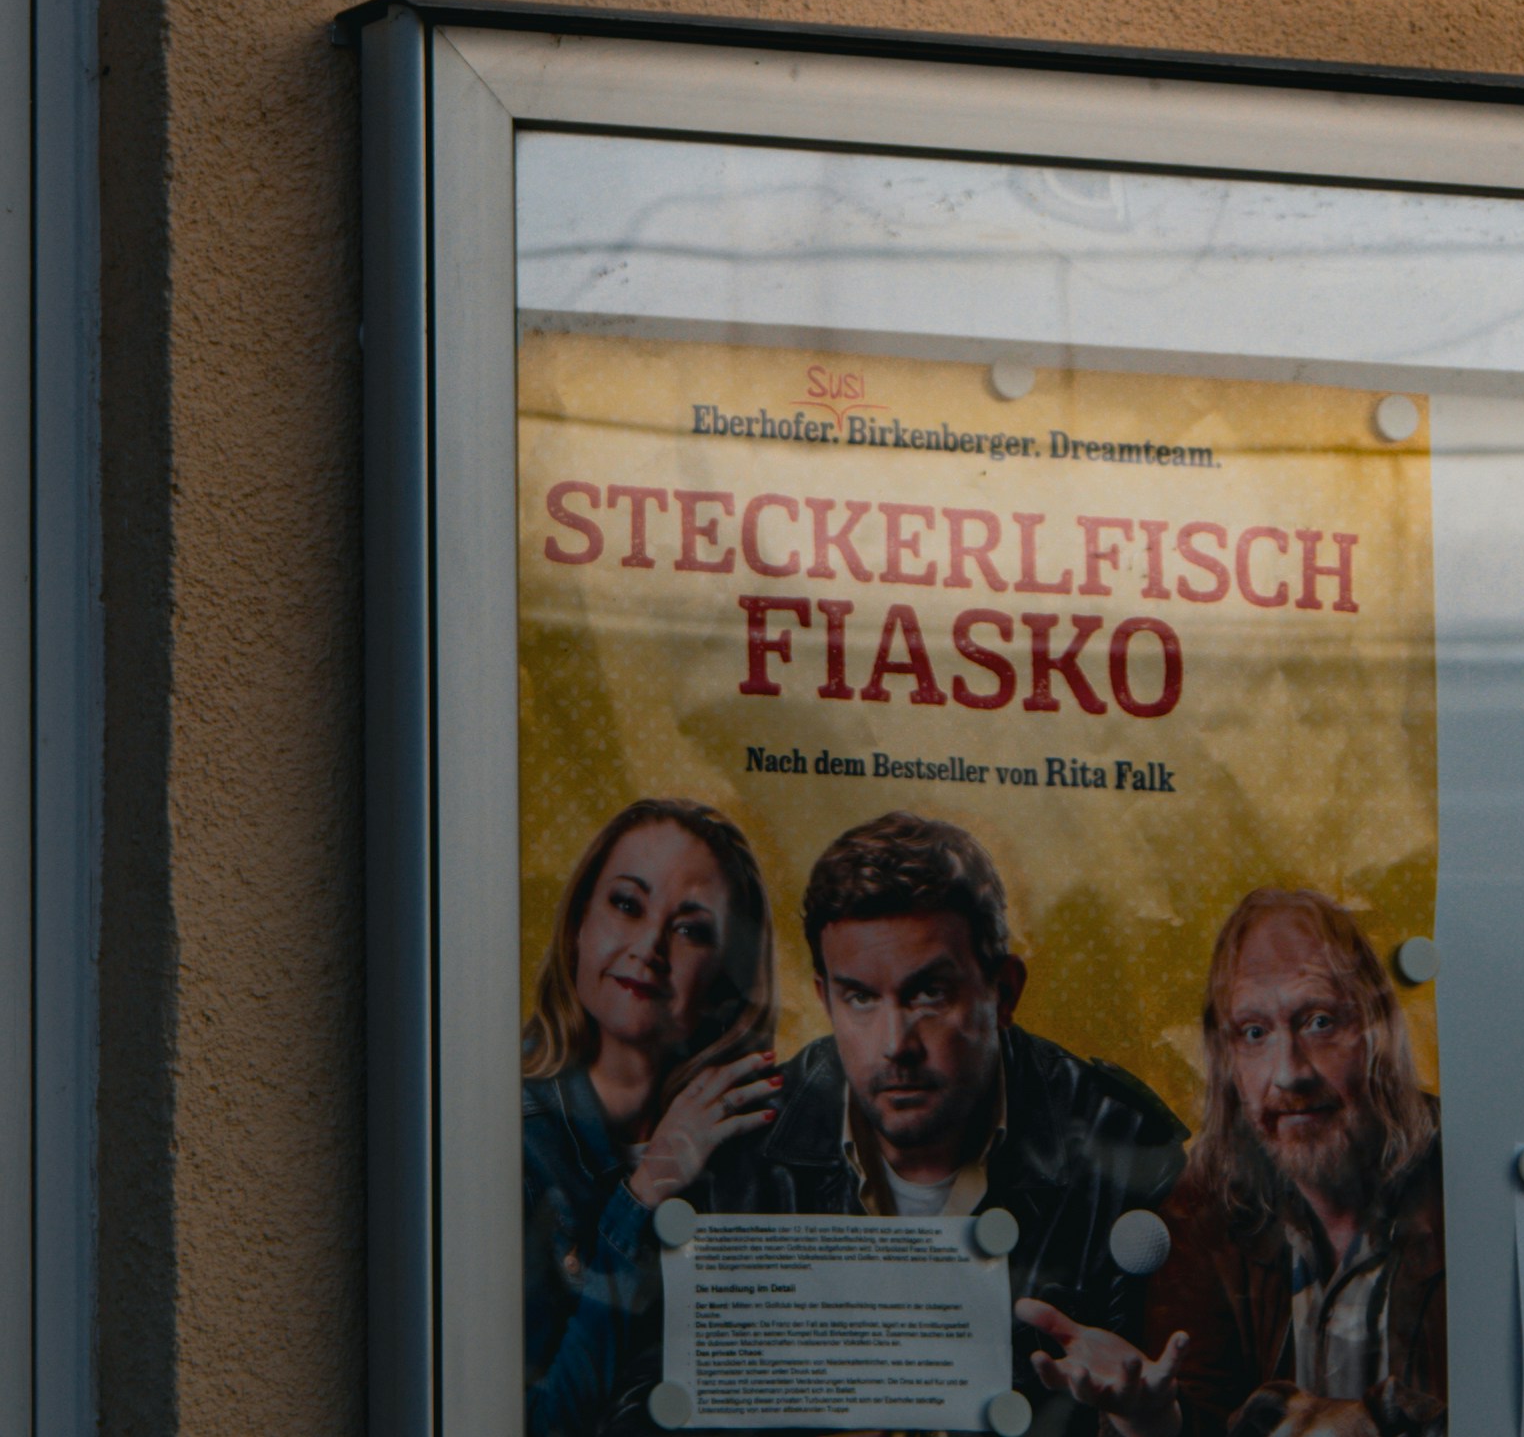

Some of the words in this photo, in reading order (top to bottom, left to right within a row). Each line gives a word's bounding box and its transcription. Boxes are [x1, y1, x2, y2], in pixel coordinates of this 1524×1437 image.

[806, 366, 866, 401] Susi
[691, 405, 840, 445] Eberhofer.
[847, 416, 1038, 461] Birkenberger.
[1049, 430, 1222, 470] Dreamteam.
[543, 480, 1361, 613] STECKERLFISCH
[737, 594, 1184, 719] FIASKO
[745, 747, 808, 777] Nach
[814, 749, 867, 778] dem
[873, 753, 990, 785] Bestseller
[997, 764, 1038, 787] von
[1045, 758, 1106, 790] Rita
[1113, 760, 1176, 794] Falk
[712, 1283, 755, 1296] Handlung
[771, 1283, 795, 1294] Detail
